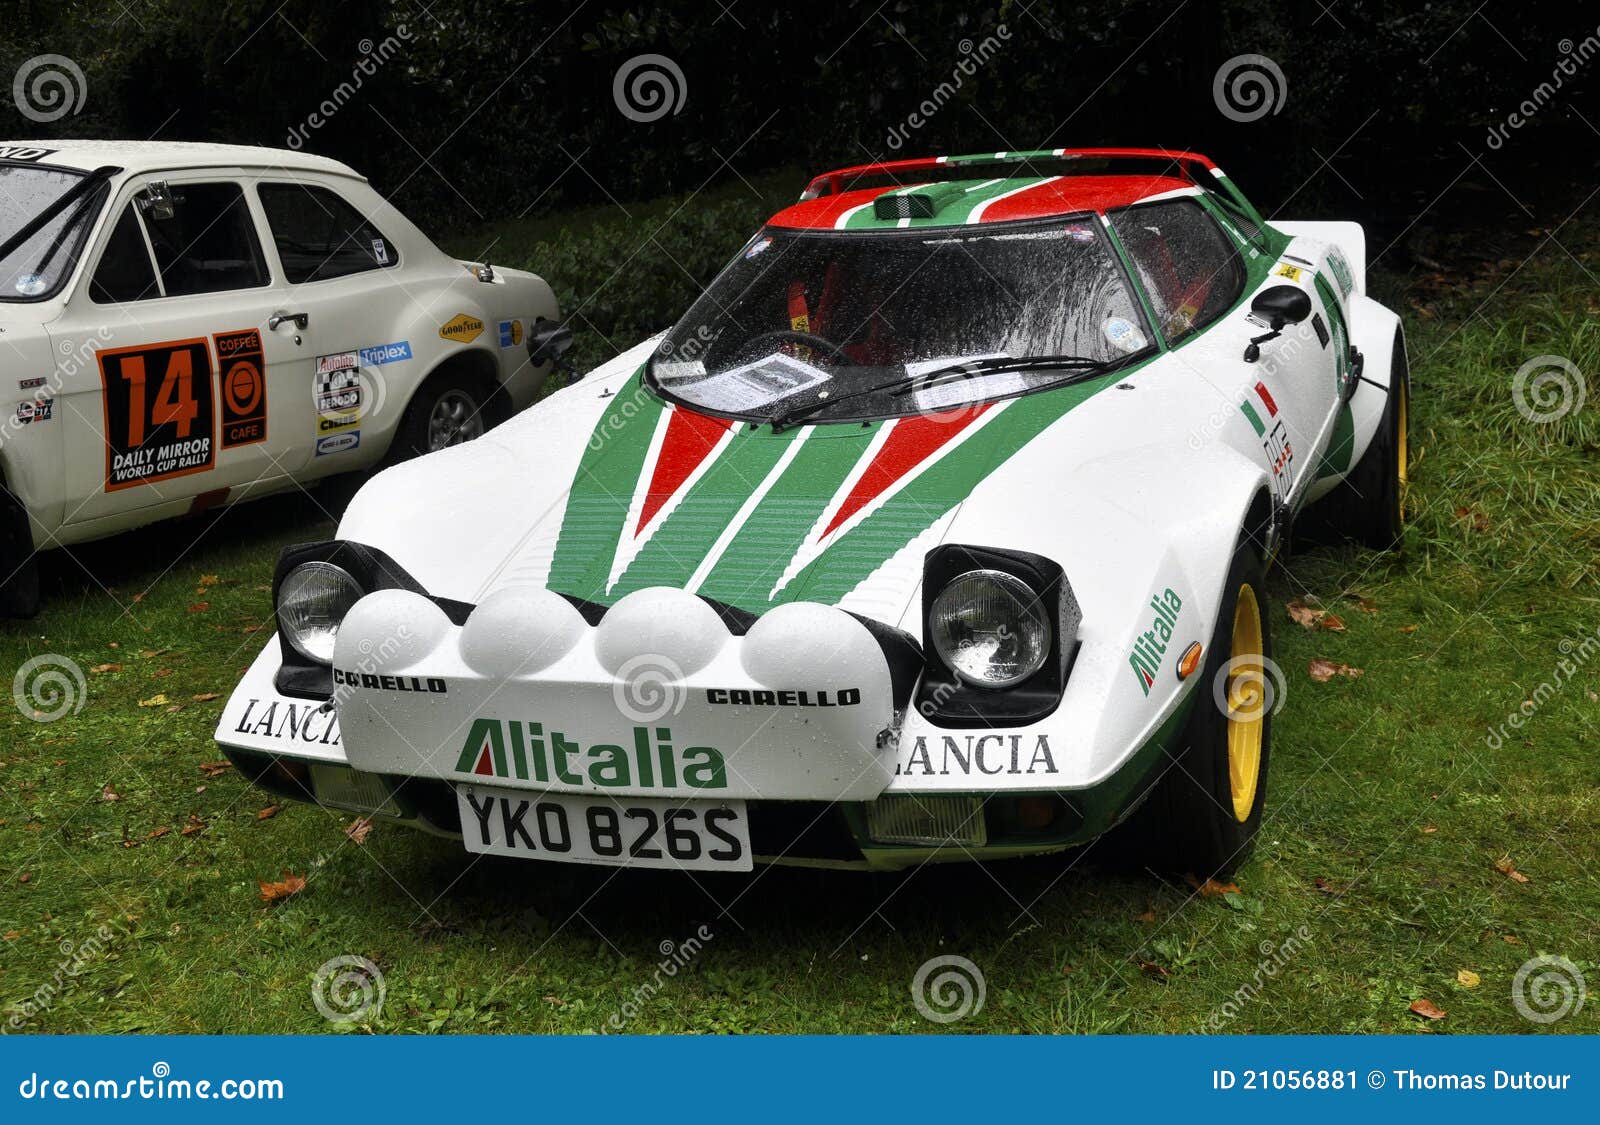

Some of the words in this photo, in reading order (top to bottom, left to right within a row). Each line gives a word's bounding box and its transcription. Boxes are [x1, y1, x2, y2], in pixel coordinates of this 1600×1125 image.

[219, 335, 259, 351] COFFEE
[363, 345, 407, 363] Triplex
[320, 354, 354, 371] Autolite
[120, 349, 198, 448] 14
[321, 392, 358, 409] FERODO
[230, 425, 259, 440] CAFE
[113, 449, 155, 470] DAILY
[157, 437, 210, 461] MIRROR
[116, 463, 154, 481] WORLD
[157, 458, 177, 473] CUP
[178, 452, 209, 468] RALLY
[1128, 588, 1182, 698] Alitalia
[334, 668, 448, 693] CARELLO
[706, 687, 861, 707] CARELLO
[235, 698, 341, 745] LANCI
[454, 718, 728, 789] Alitalia
[896, 734, 1059, 776] ANCIA
[466, 792, 572, 853] YKO
[585, 805, 743, 861] 826S
